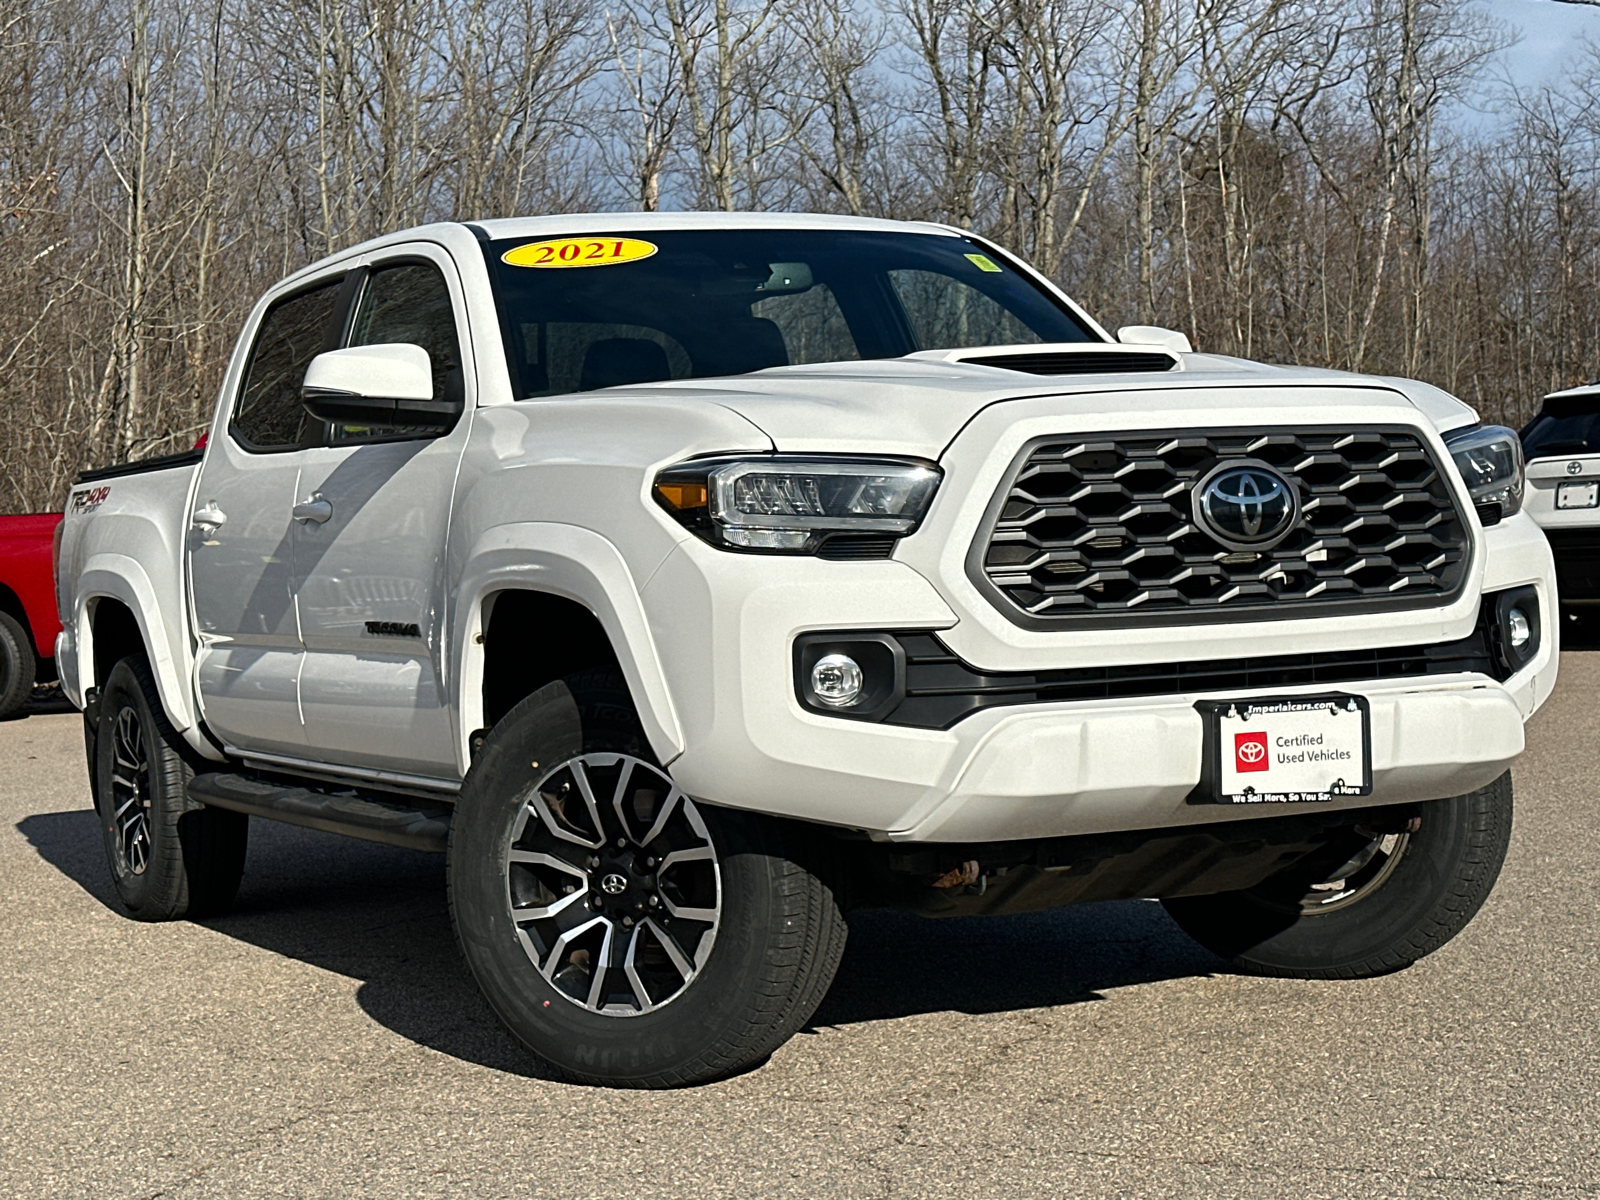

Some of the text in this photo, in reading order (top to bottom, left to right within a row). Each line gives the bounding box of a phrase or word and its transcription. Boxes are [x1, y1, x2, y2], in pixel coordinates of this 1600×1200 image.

[534, 241, 624, 264] 2021
[1276, 733, 1323, 747] Certified
[1277, 748, 1351, 764] Used Vehicles
